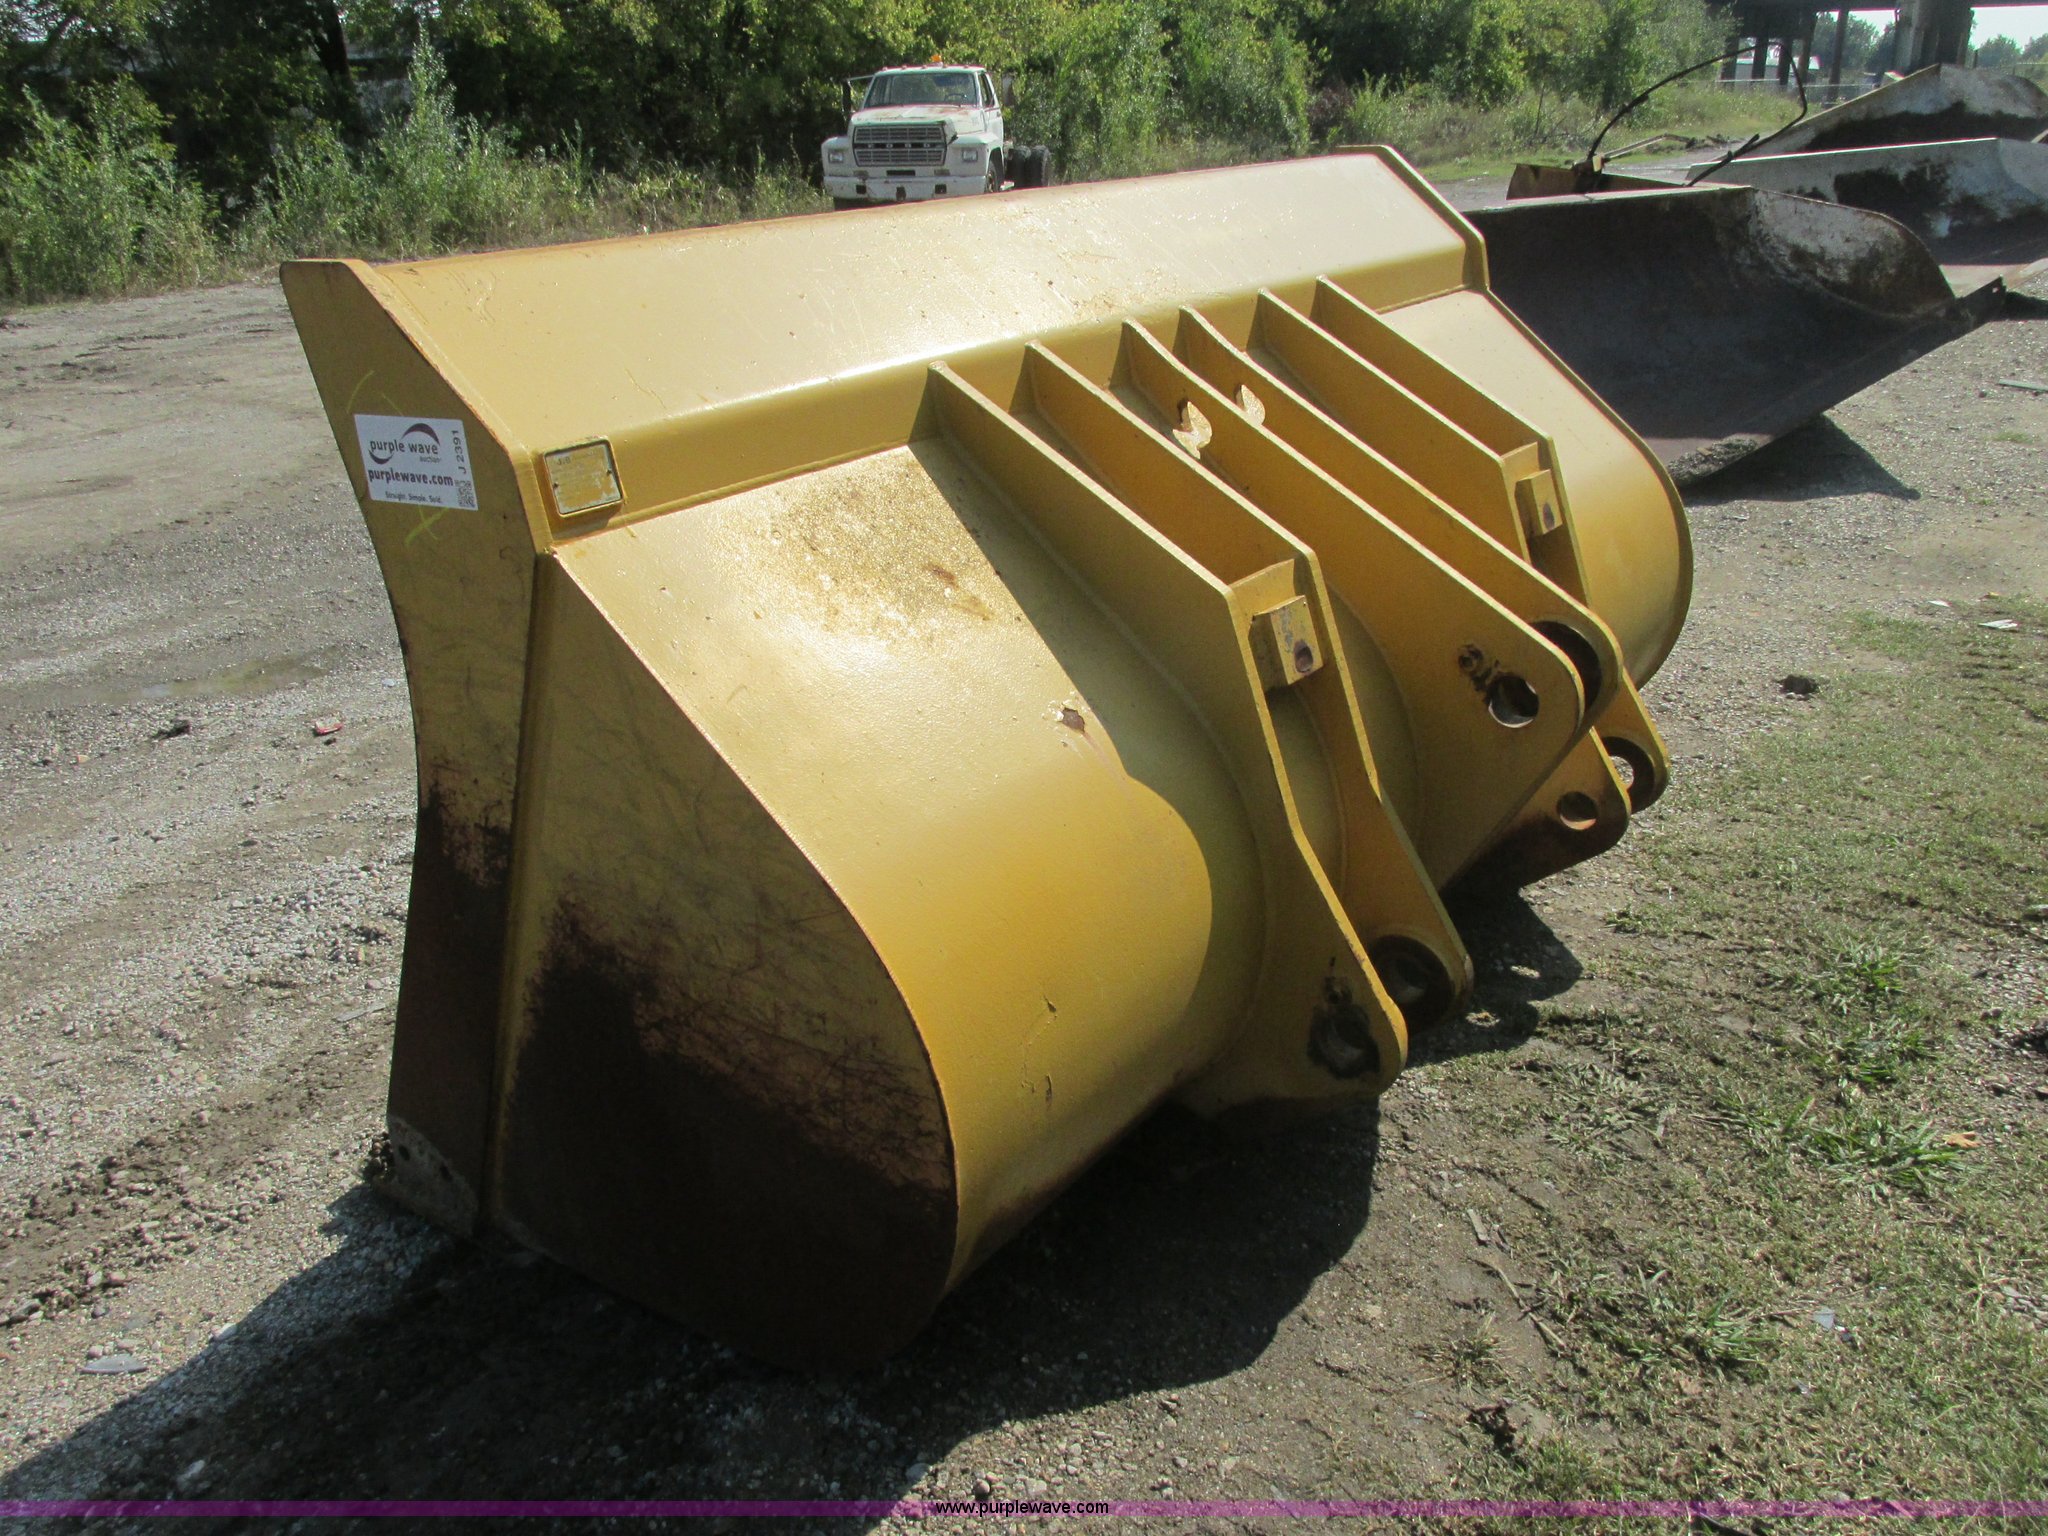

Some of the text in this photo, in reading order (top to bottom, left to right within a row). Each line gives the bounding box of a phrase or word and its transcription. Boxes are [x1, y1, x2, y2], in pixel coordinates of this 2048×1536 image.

[369, 439, 439, 455] purple wave
[451, 430, 465, 463] 2391
[367, 467, 454, 487] purplewave.com
